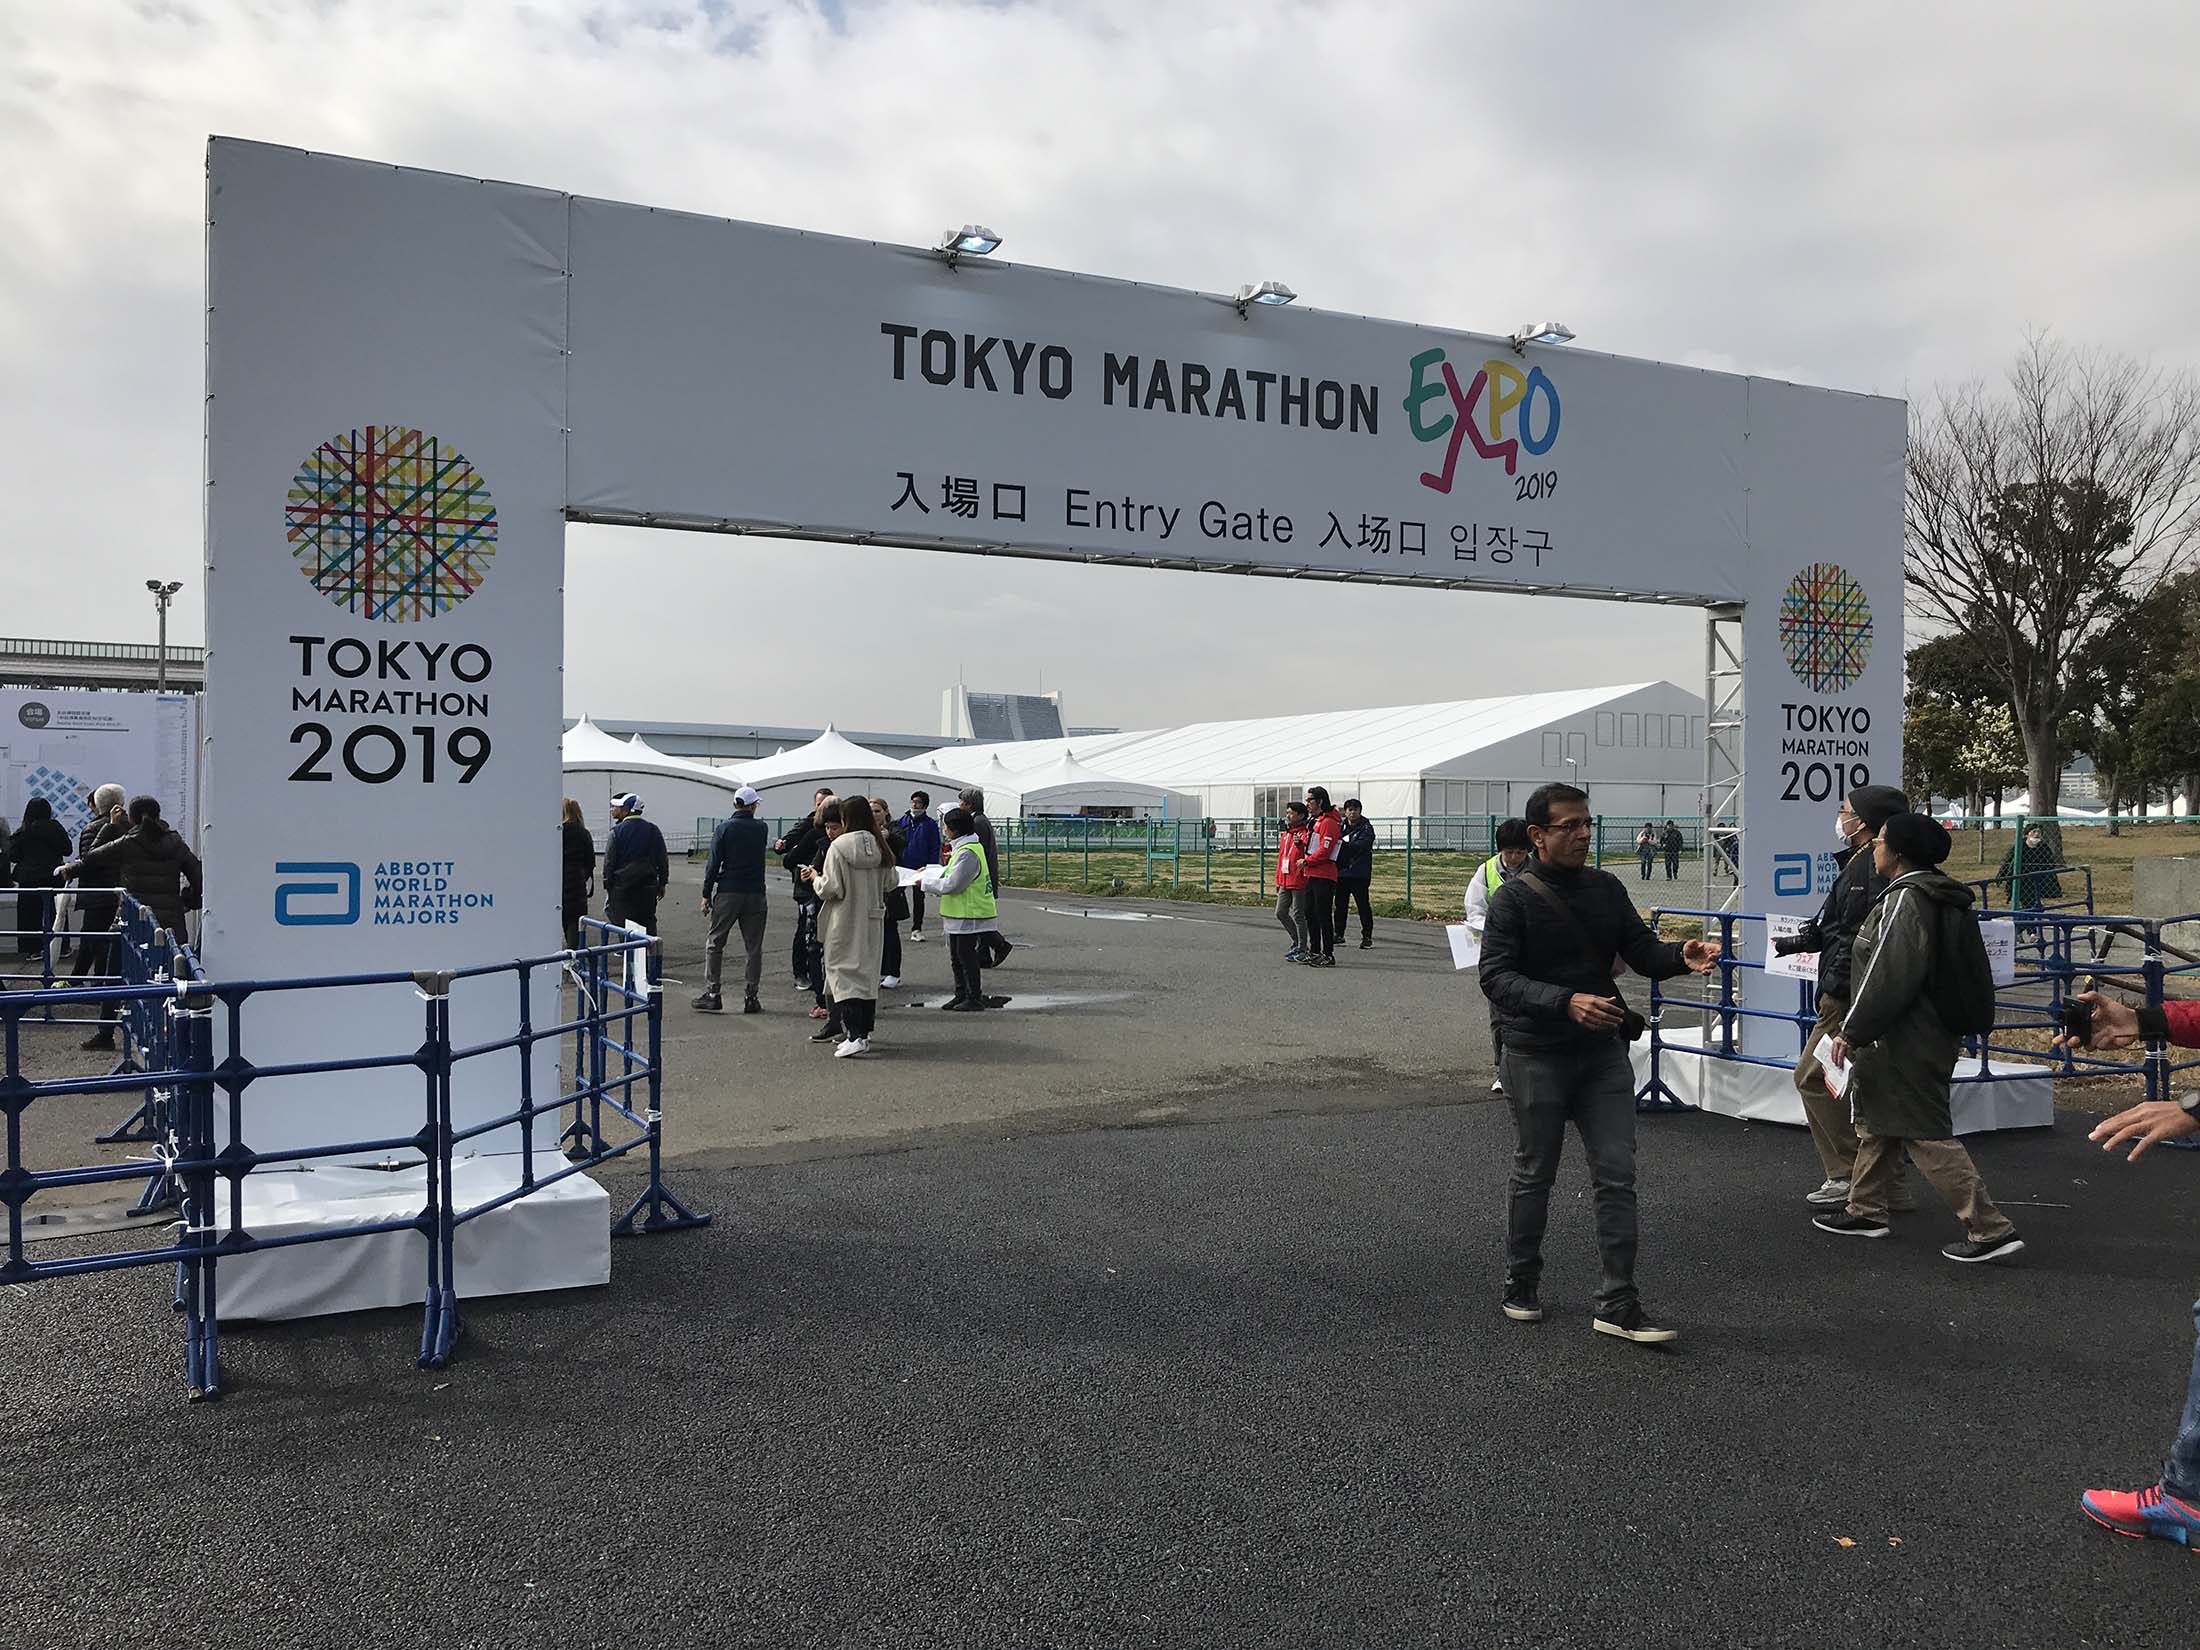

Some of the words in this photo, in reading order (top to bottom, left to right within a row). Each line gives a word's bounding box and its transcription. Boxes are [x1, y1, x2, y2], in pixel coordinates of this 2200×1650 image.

[880, 322, 1073, 401] TOKYO
[1103, 351, 1379, 436] MARATHON
[1402, 347, 1560, 494] EXPO
[890, 471, 1026, 523] 入場口
[1514, 470, 1558, 501] 2019
[1066, 488, 1181, 540] Entry
[1199, 500, 1294, 544] Gate
[1317, 511, 1427, 557] 入场口
[1450, 523, 1555, 568] 입장구
[288, 635, 493, 683] TOKYO
[292, 686, 489, 718] MARATHON
[1780, 703, 1871, 735] TOKYO
[287, 722, 492, 785] 2019
[1781, 737, 1870, 758] MARATHON
[1780, 760, 1870, 802] 2019
[374, 861, 455, 876] ABBOTT
[374, 878, 448, 892] WORLD
[374, 893, 494, 909] MARATHON
[374, 909, 460, 925] MAJORS
